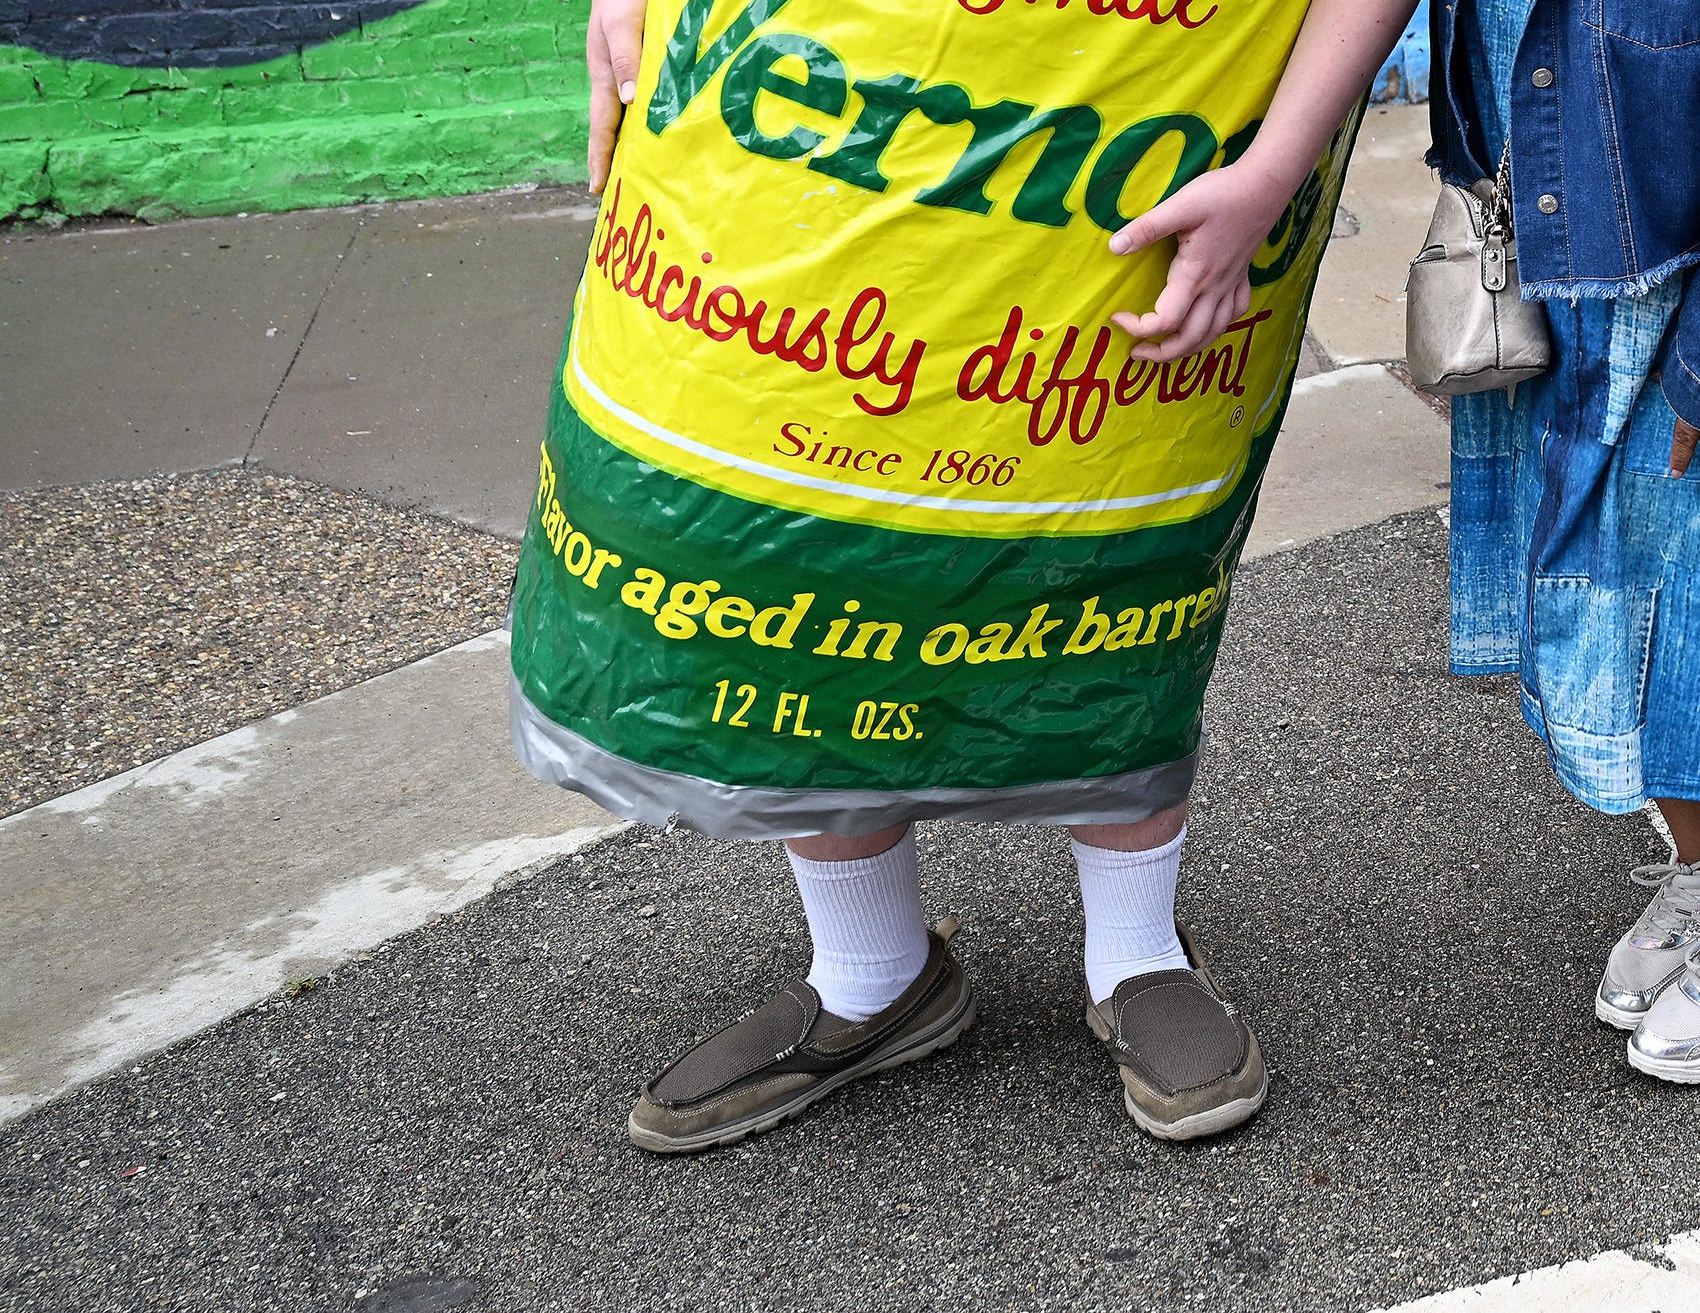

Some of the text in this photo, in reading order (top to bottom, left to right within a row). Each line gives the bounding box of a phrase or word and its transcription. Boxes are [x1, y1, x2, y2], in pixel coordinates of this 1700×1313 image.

[596, 177, 927, 417] deliciously
[956, 306, 1273, 447] different
[772, 421, 1022, 488] Since 1866
[537, 440, 623, 590] Flavor
[620, 567, 816, 650] aged
[813, 600, 903, 663] in
[919, 601, 1066, 667] oak
[711, 679, 925, 742] 12 FL. OZS.
